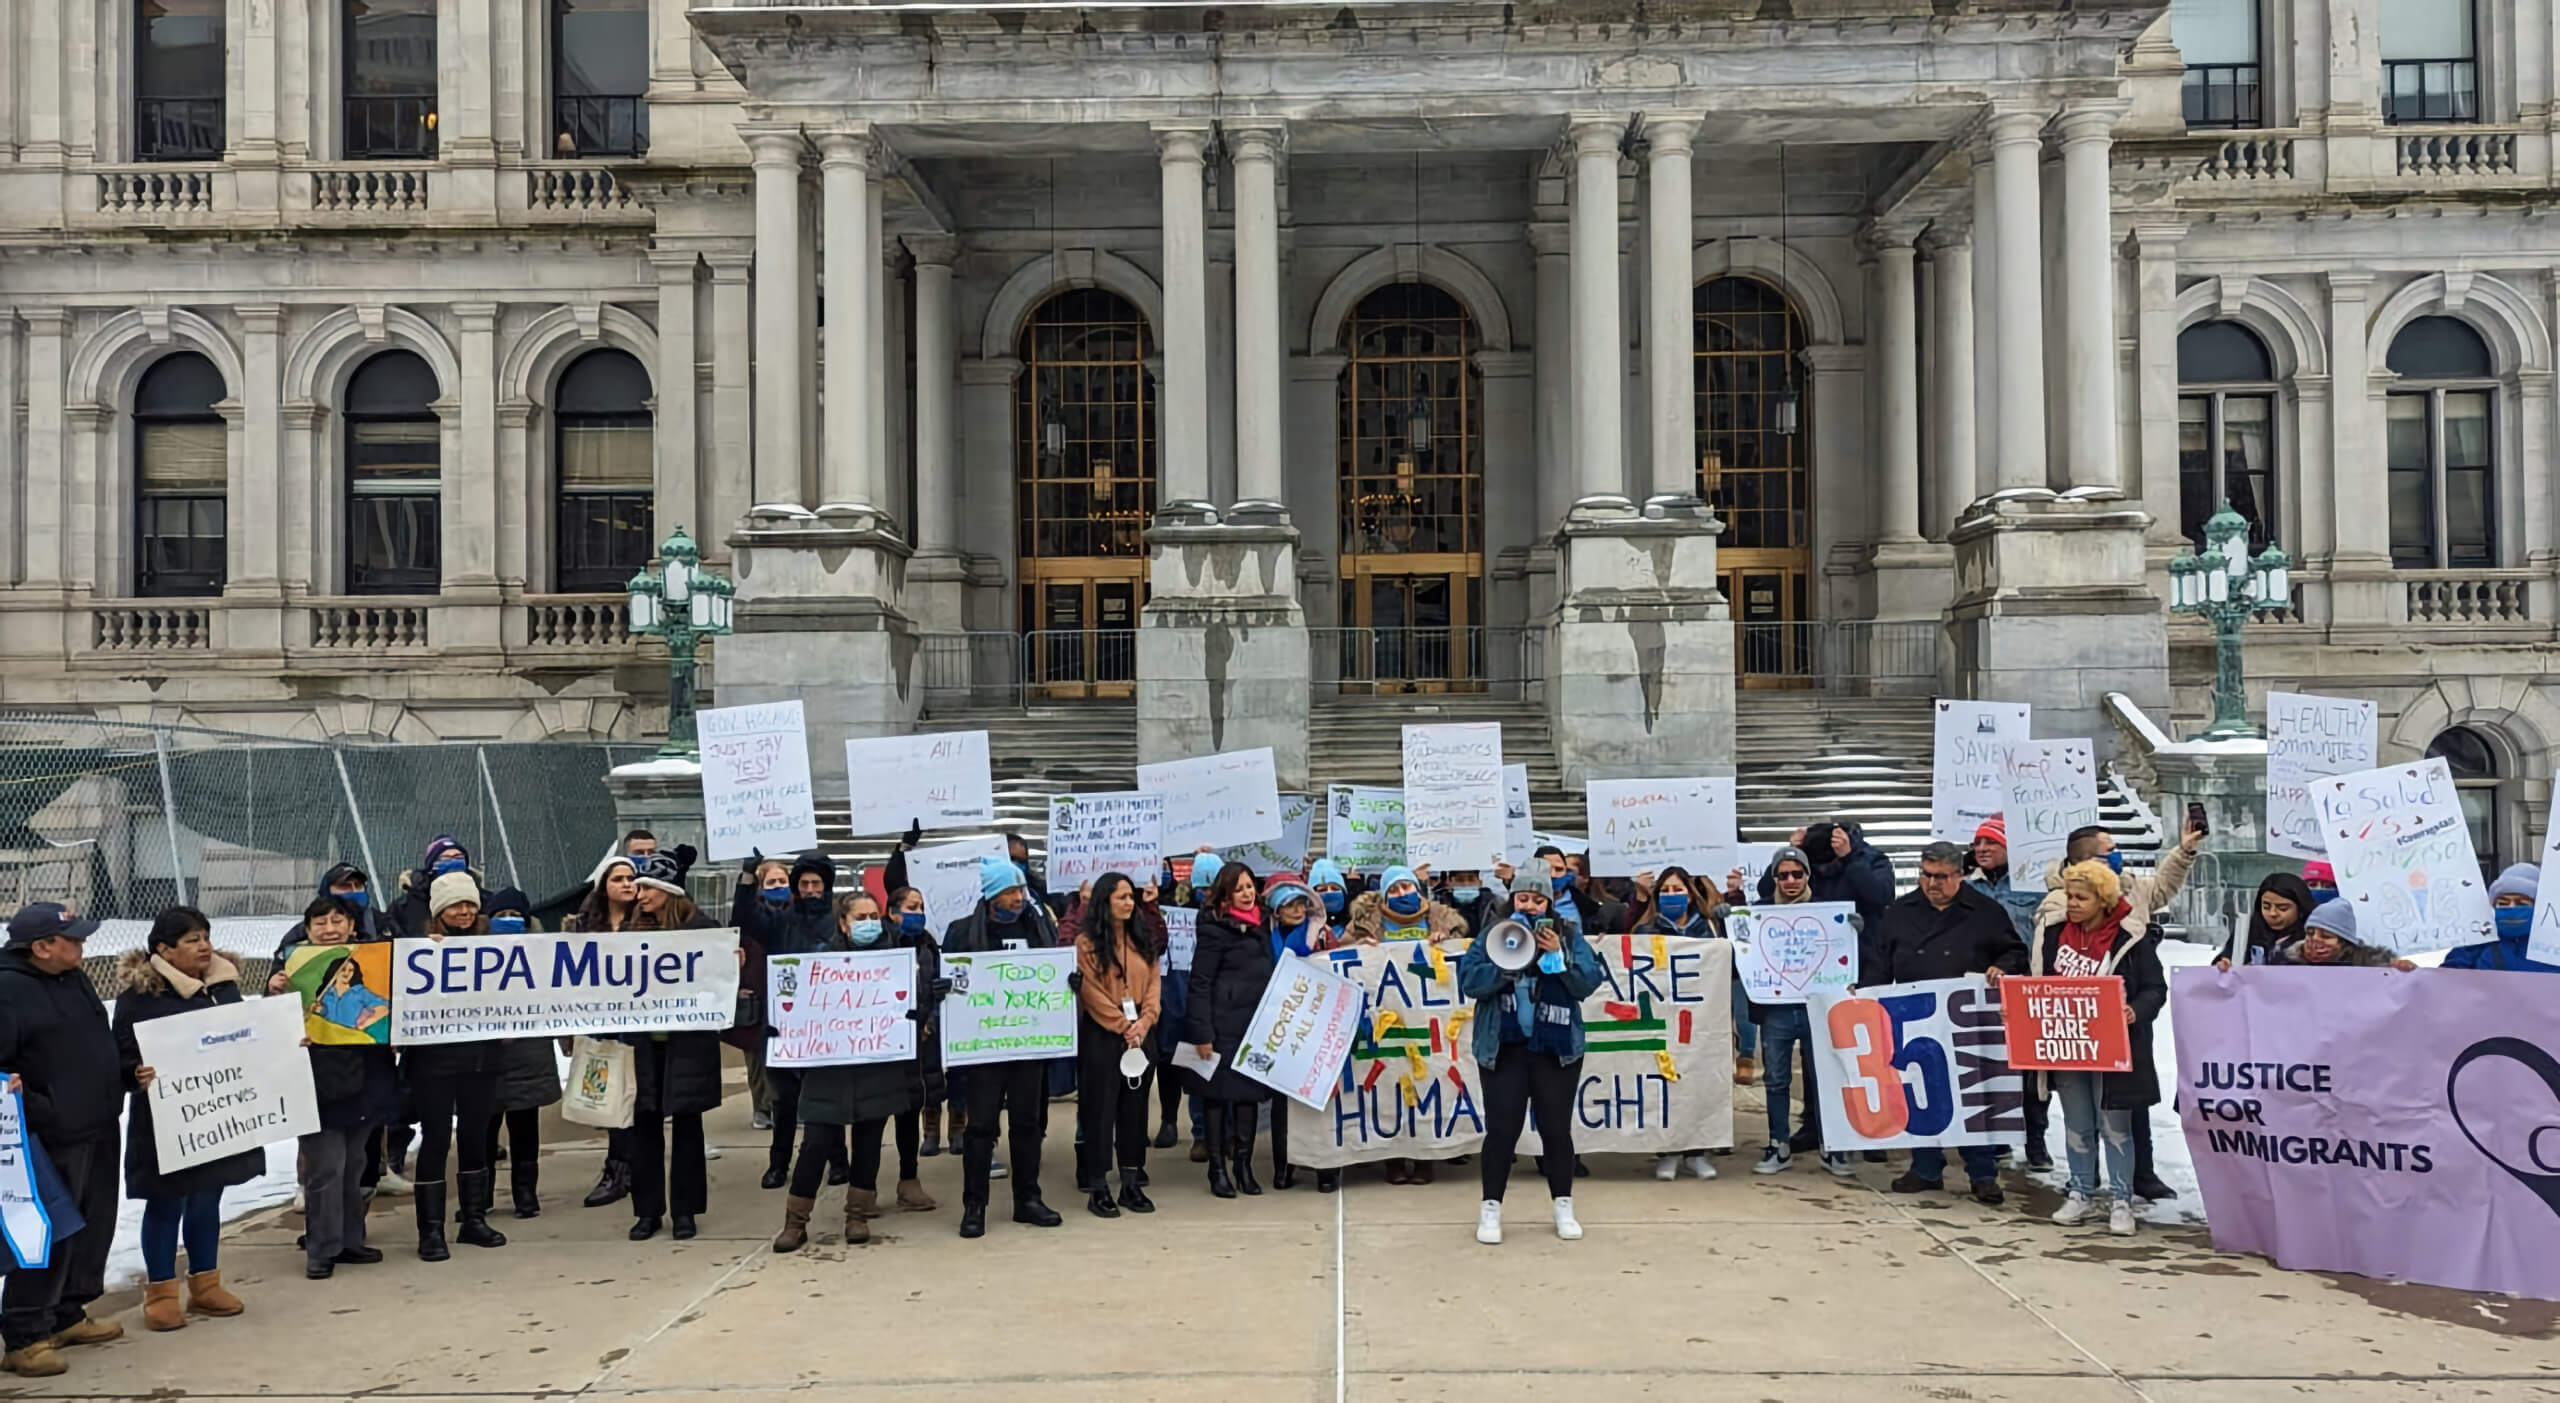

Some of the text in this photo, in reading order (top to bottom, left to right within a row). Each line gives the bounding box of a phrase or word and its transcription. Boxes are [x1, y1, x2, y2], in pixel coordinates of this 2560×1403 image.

[2279, 703, 2370, 736] HEALTHY
[405, 940, 704, 998] SEPA Mujer
[1599, 952, 1705, 1003] ARE
[2022, 984, 2100, 995] NY Deserves
[402, 998, 698, 1021] SERVICIOS PARA EL AVANCE DE LA MUJER
[402, 1011, 727, 1037] SERVICES FOR THE ADVANCEMENT OF WOMEN
[2028, 997, 2098, 1019] HEALTH
[2041, 1018, 2090, 1039] CARE
[1827, 987, 2026, 1140] 35 NYIC
[2035, 1039, 2099, 1063] EQUITY
[157, 1065, 244, 1100] Everyone
[2194, 1061, 2332, 1093] JUSTICE
[181, 1086, 258, 1123] Deserves
[1335, 1076, 1486, 1148] HUMA
[2197, 1097, 2266, 1126] FOR
[2208, 1128, 2433, 1173] IMMIGRANTS
